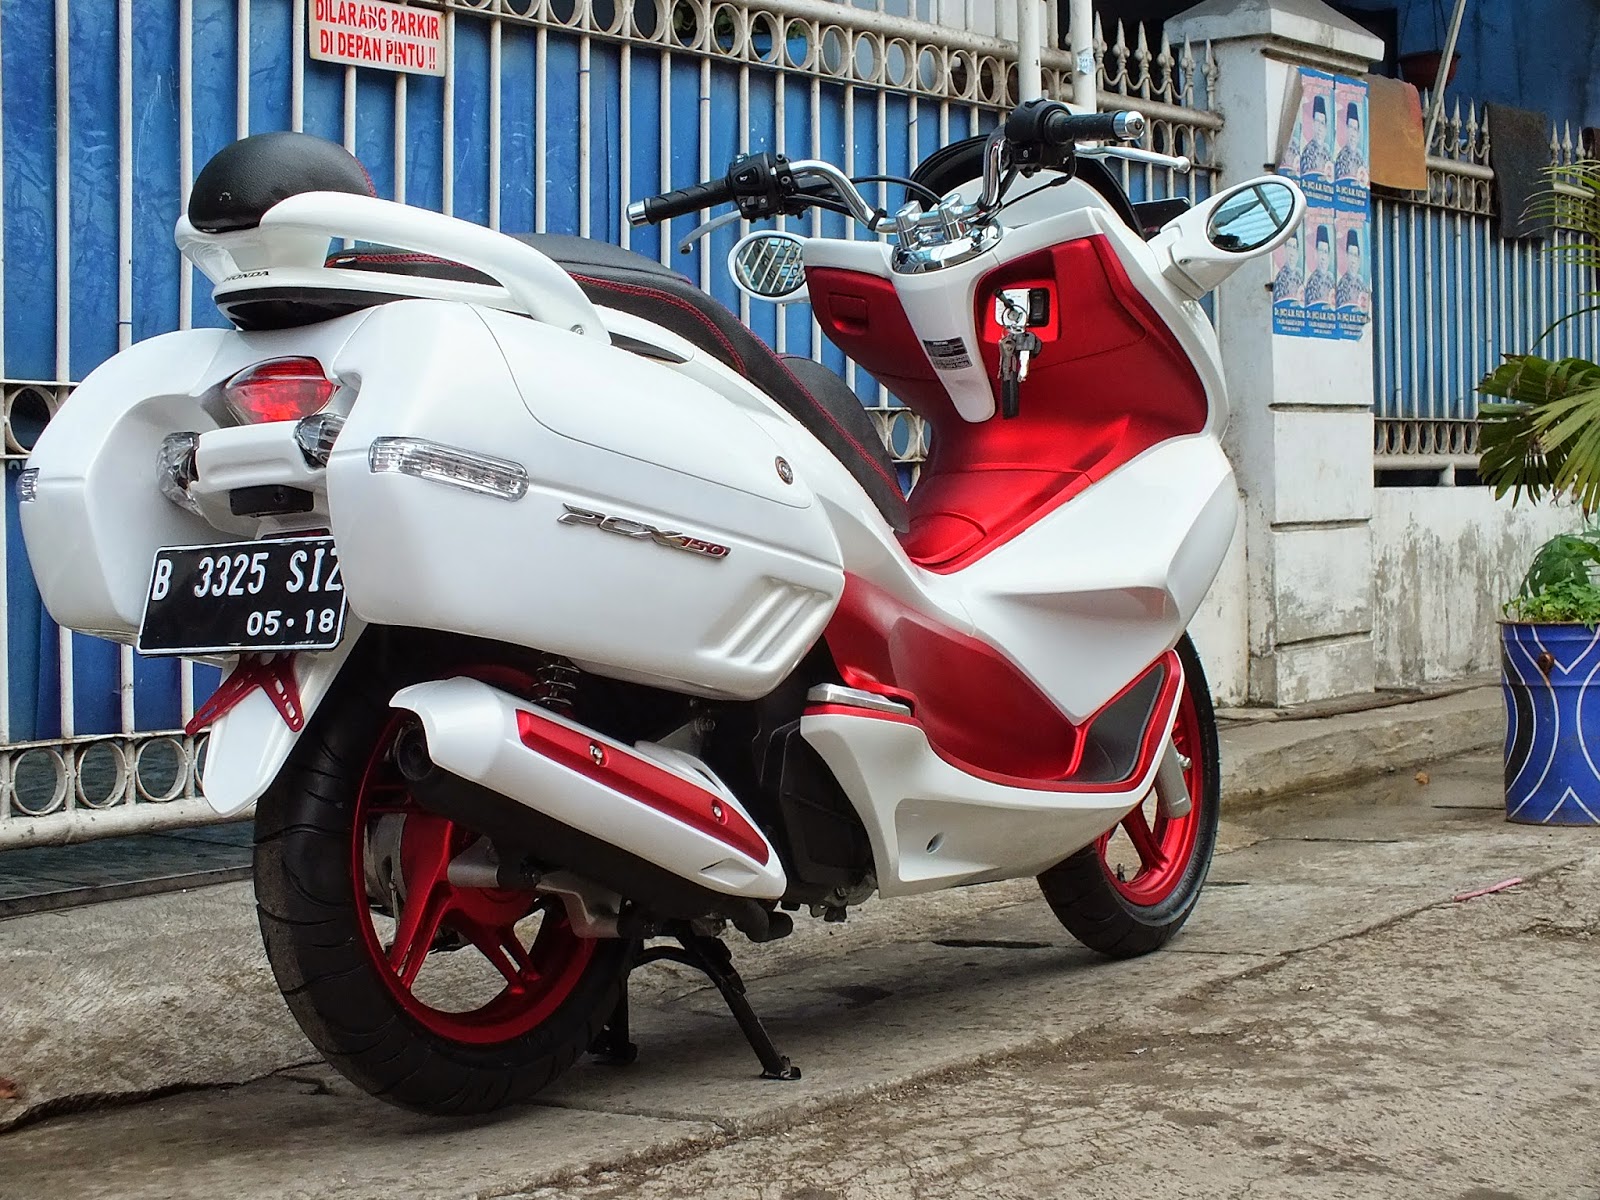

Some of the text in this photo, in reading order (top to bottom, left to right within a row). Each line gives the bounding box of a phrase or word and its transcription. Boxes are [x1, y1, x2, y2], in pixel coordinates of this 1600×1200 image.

[315, 0, 439, 41] DILARANG PARKIR
[320, 29, 333, 55] DI
[338, 32, 382, 62] DEPAN
[386, 40, 425, 68] PINTU
[223, 270, 269, 282] HONDA
[557, 502, 732, 560] PCX 150
[151, 558, 173, 601] B
[194, 552, 269, 598] 3325
